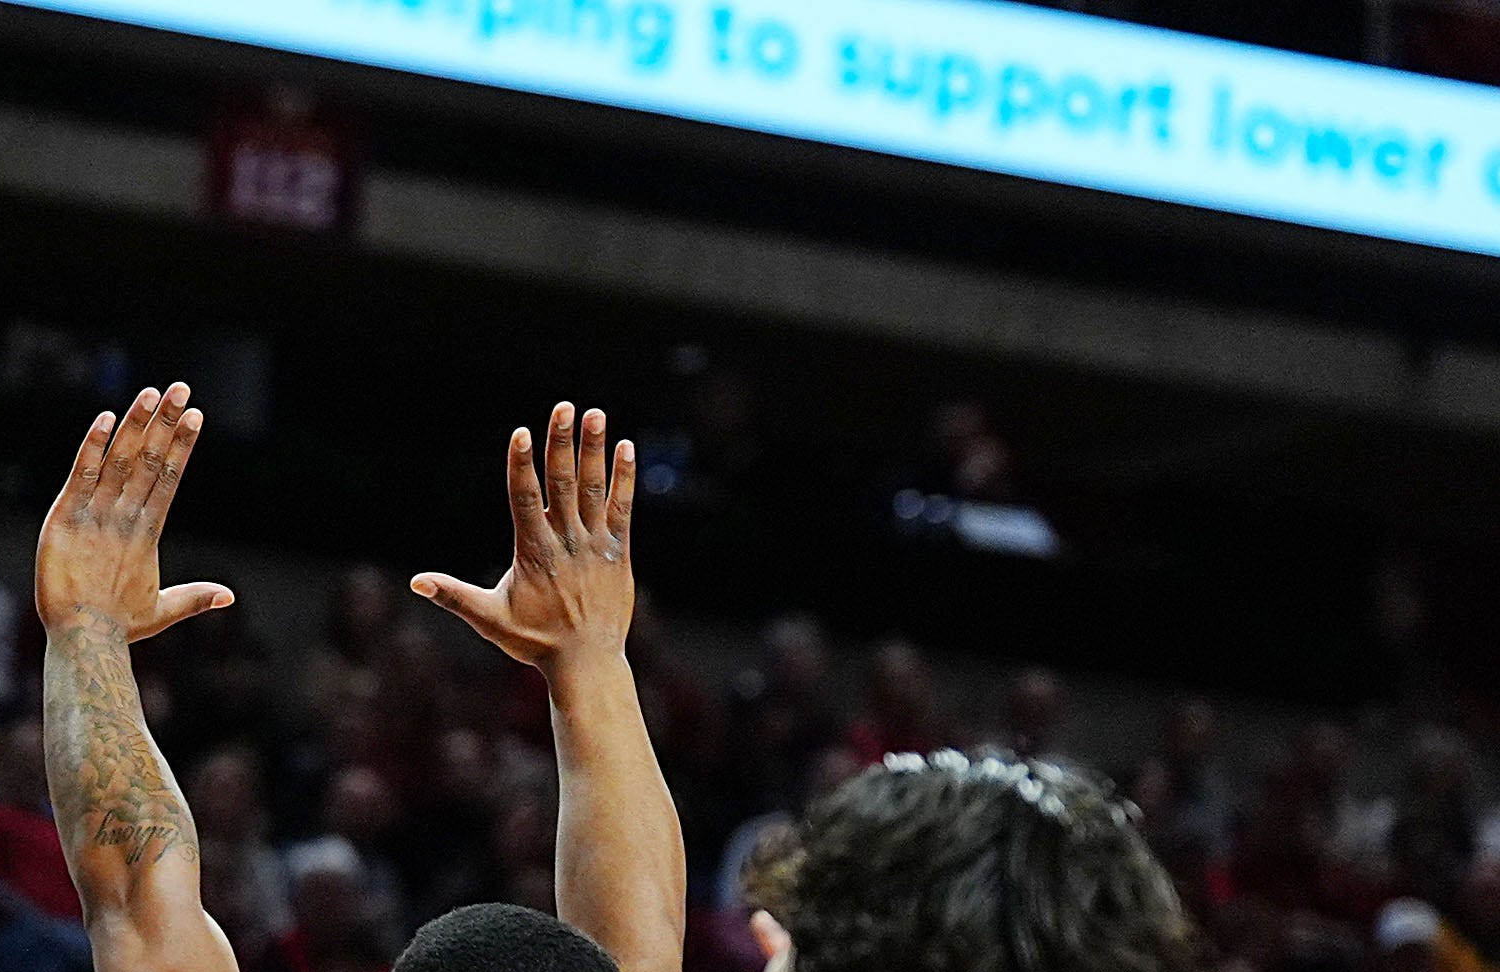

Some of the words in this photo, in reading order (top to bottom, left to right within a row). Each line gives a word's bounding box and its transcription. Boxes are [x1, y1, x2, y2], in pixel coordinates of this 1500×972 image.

[708, 2, 800, 79] to
[835, 34, 1175, 150] support
[1206, 76, 1448, 190] lower
